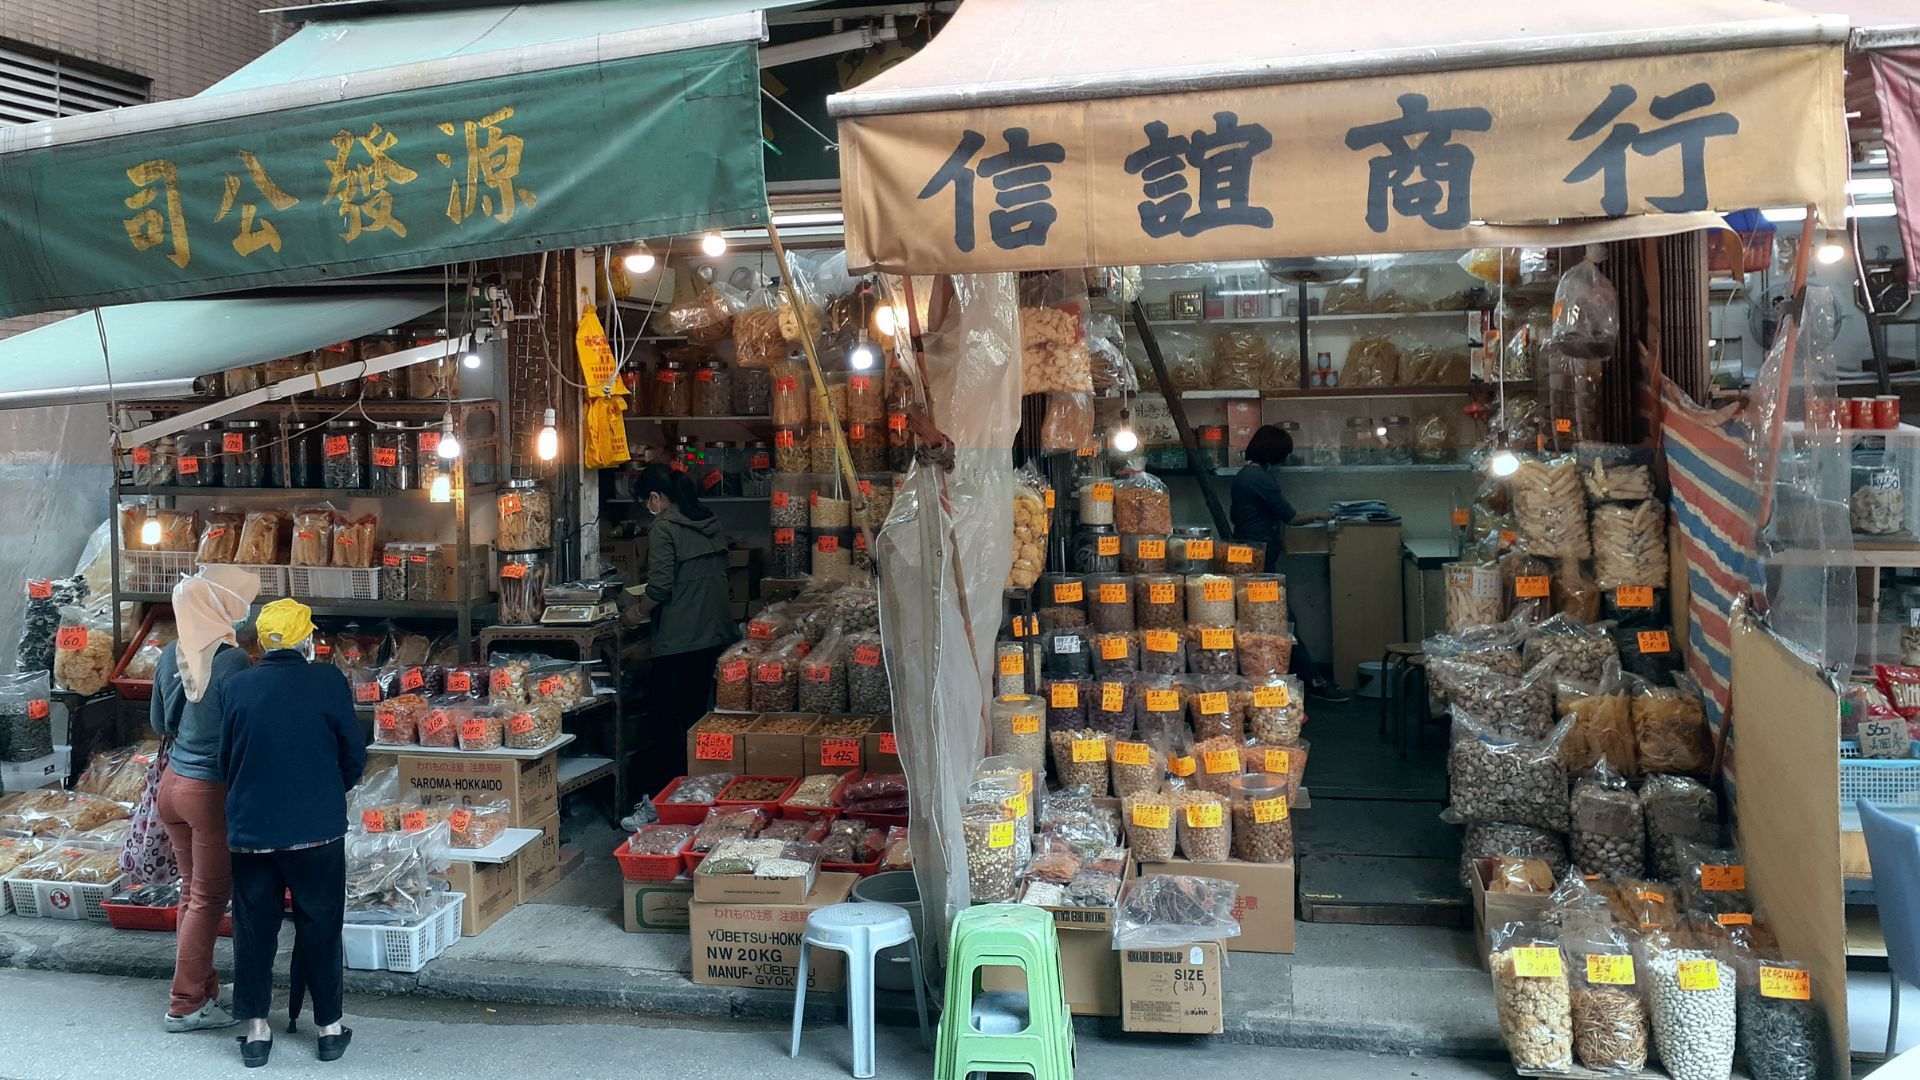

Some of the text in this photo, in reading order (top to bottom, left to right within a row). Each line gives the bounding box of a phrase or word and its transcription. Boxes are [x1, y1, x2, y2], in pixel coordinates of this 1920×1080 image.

[918, 84, 1740, 253] 信誼商行
[707, 946, 733, 961] NW
[755, 964, 816, 978] YŪBETU
[1174, 968, 1204, 981] SIZE
[755, 975, 816, 989] GYOKO
